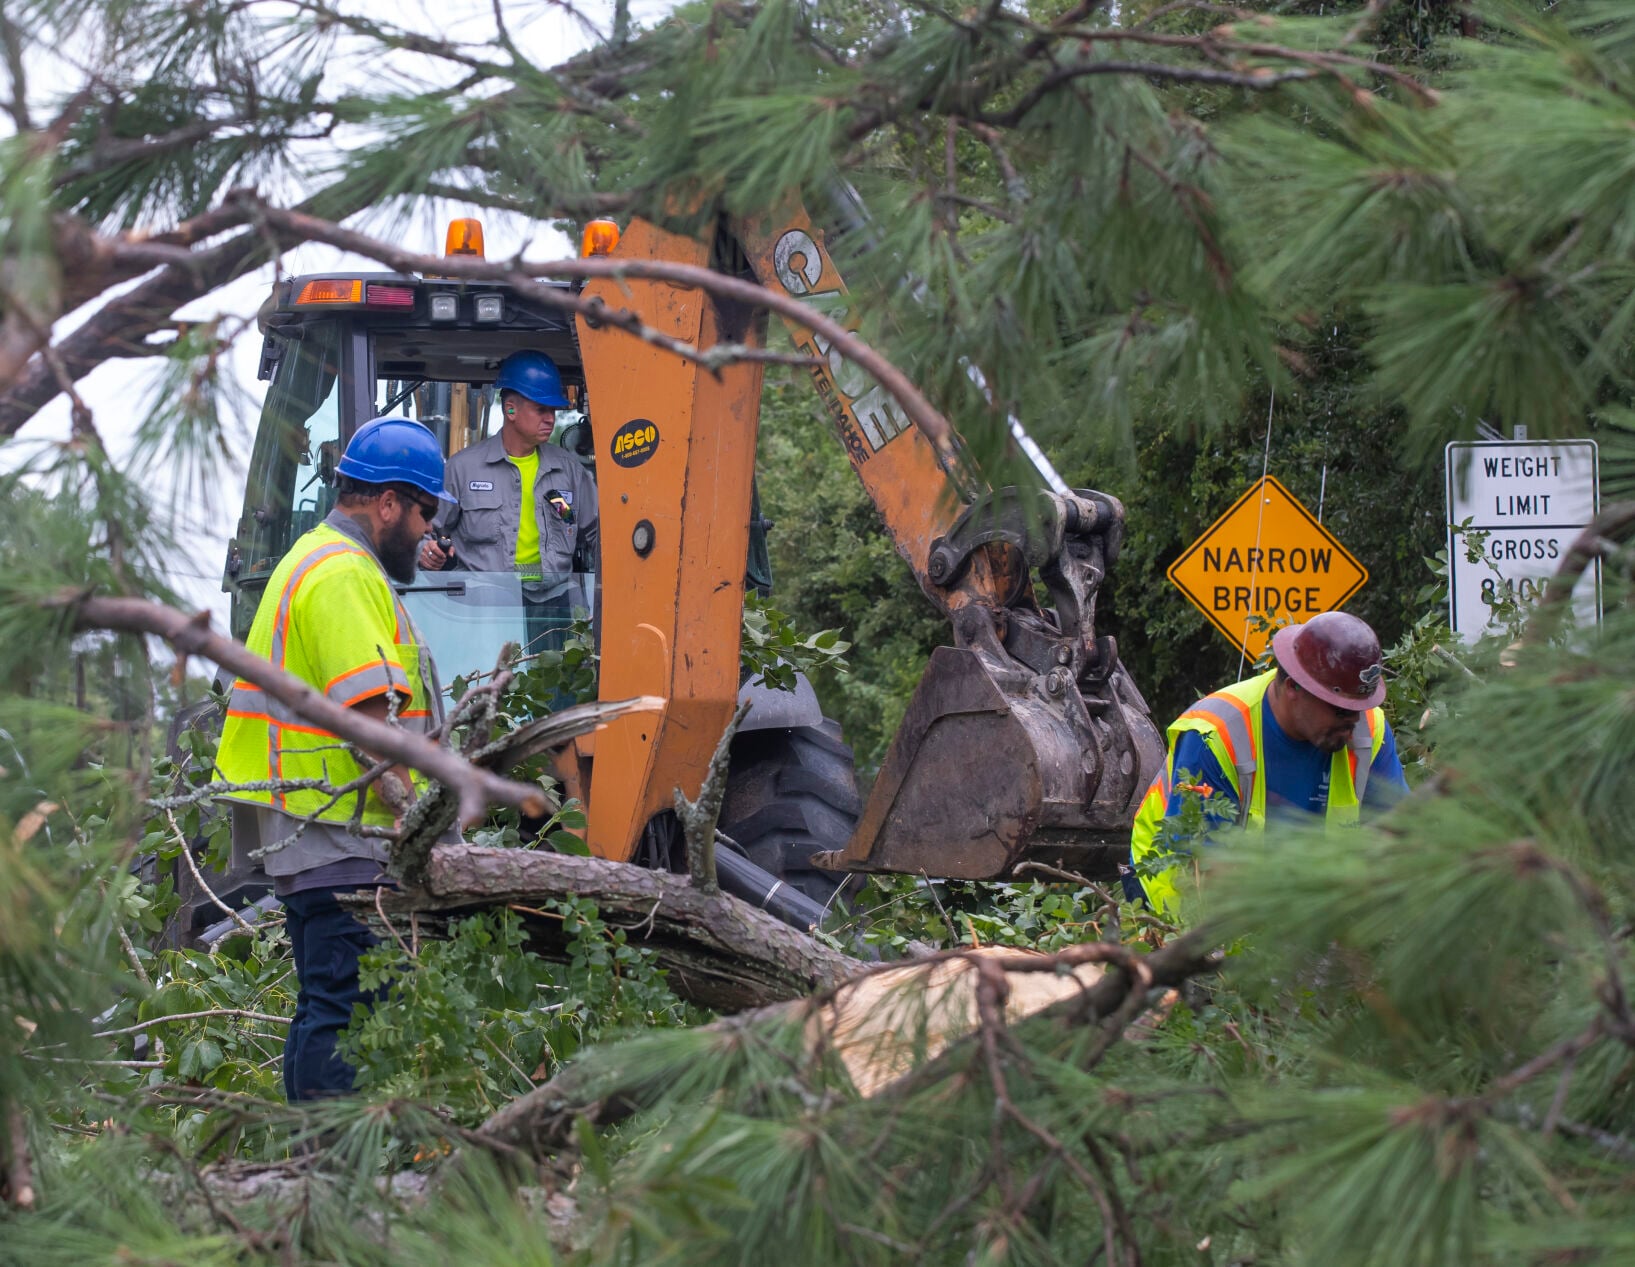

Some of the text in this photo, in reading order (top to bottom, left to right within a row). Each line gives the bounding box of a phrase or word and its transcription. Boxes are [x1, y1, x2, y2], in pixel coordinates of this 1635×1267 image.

[615, 425, 656, 455] ASCO
[1484, 457, 1561, 477] WEIGHT
[1496, 495, 1550, 515] LIMIT
[1203, 547, 1332, 573] NARROW
[1491, 539, 1559, 559] GROSS
[1214, 586, 1321, 612] BRIDGE
